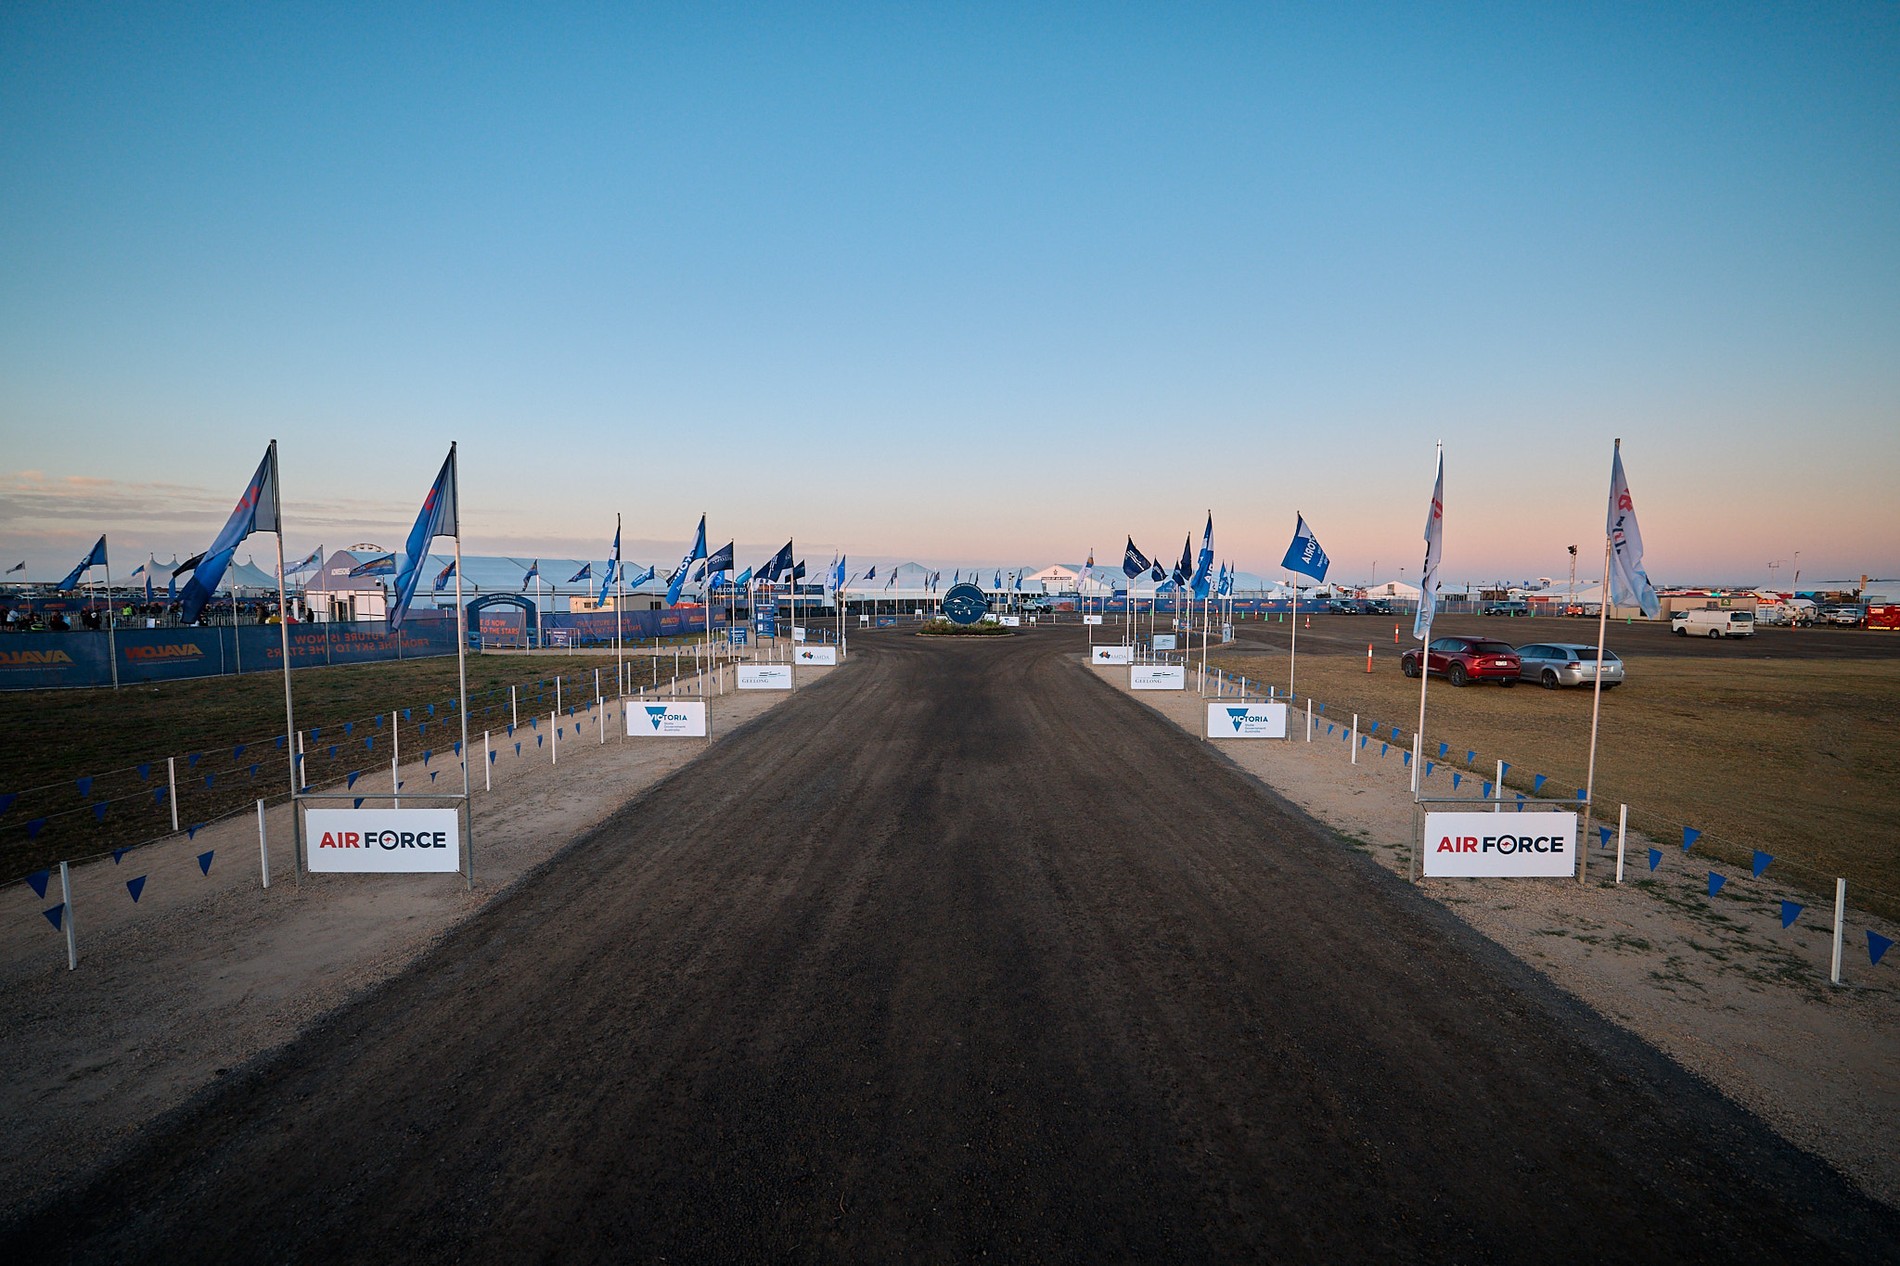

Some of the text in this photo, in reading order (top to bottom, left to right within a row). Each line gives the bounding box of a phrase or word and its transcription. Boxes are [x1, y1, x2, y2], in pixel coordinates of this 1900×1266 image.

[319, 830, 446, 851] AIR FORCE
[1436, 834, 1564, 855] AIR FORCE
